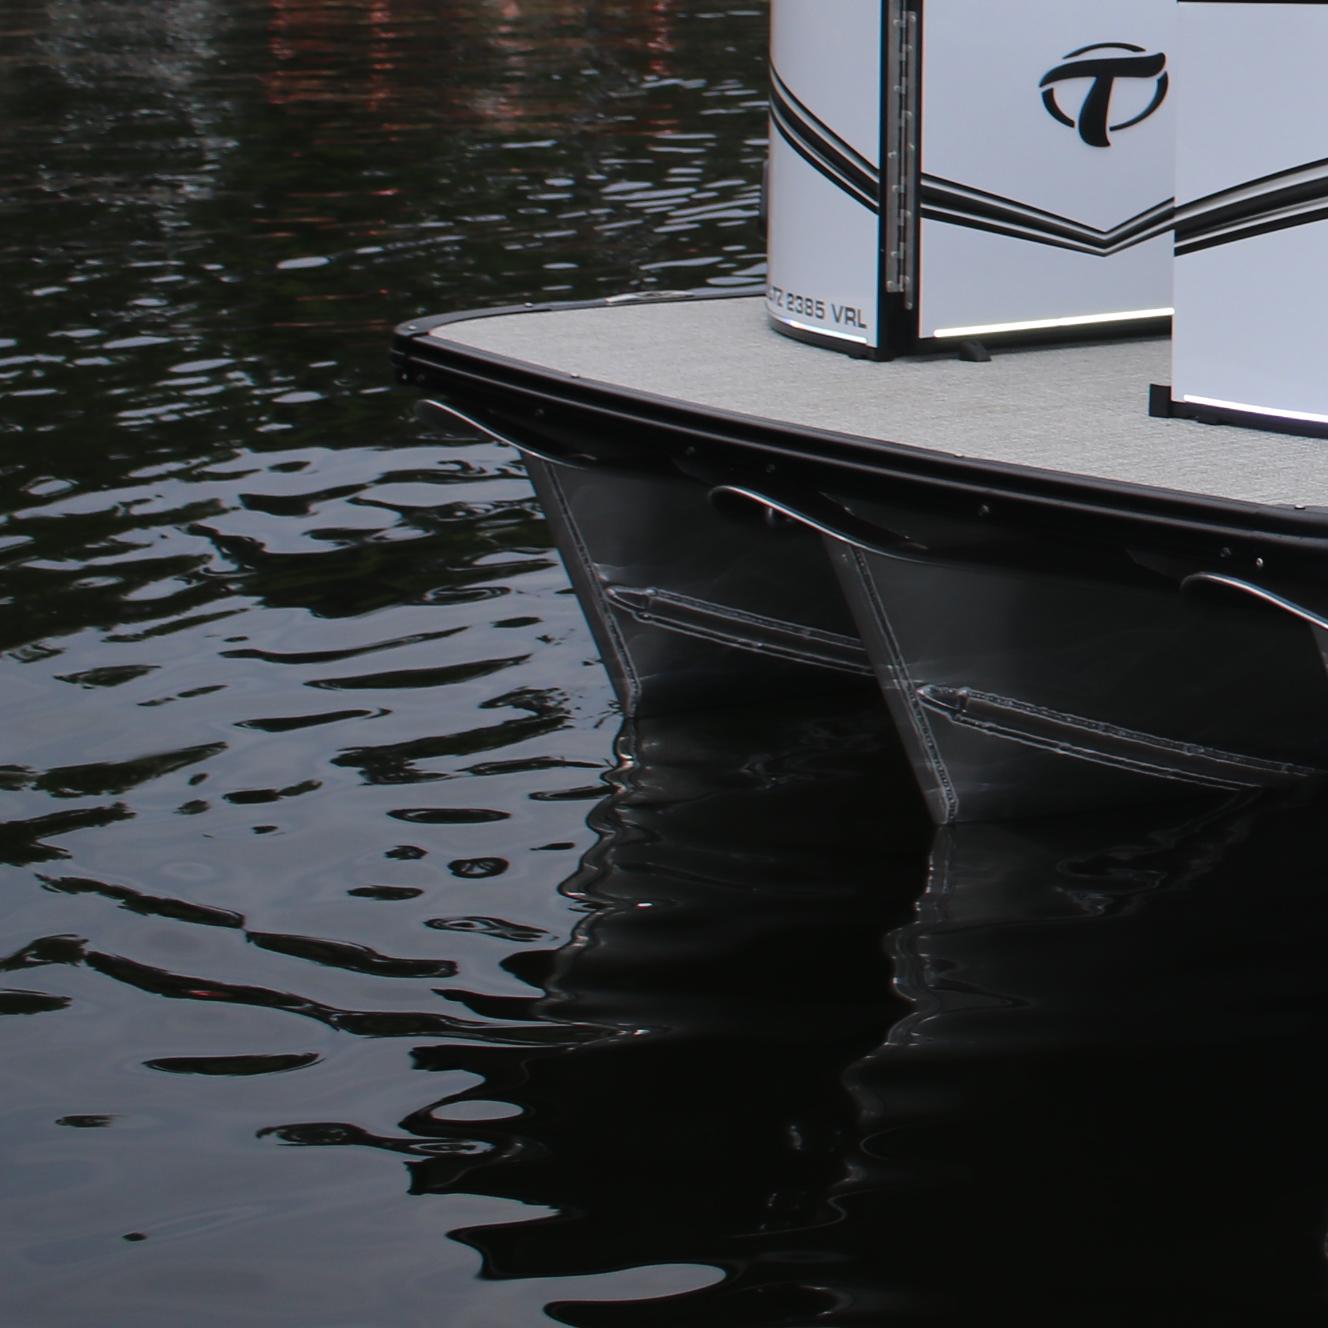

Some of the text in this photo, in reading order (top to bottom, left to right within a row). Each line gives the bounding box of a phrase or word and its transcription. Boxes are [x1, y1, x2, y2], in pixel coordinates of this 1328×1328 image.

[1039, 47, 1168, 147] T
[786, 292, 825, 320] 2385
[831, 303, 867, 328] VRL
